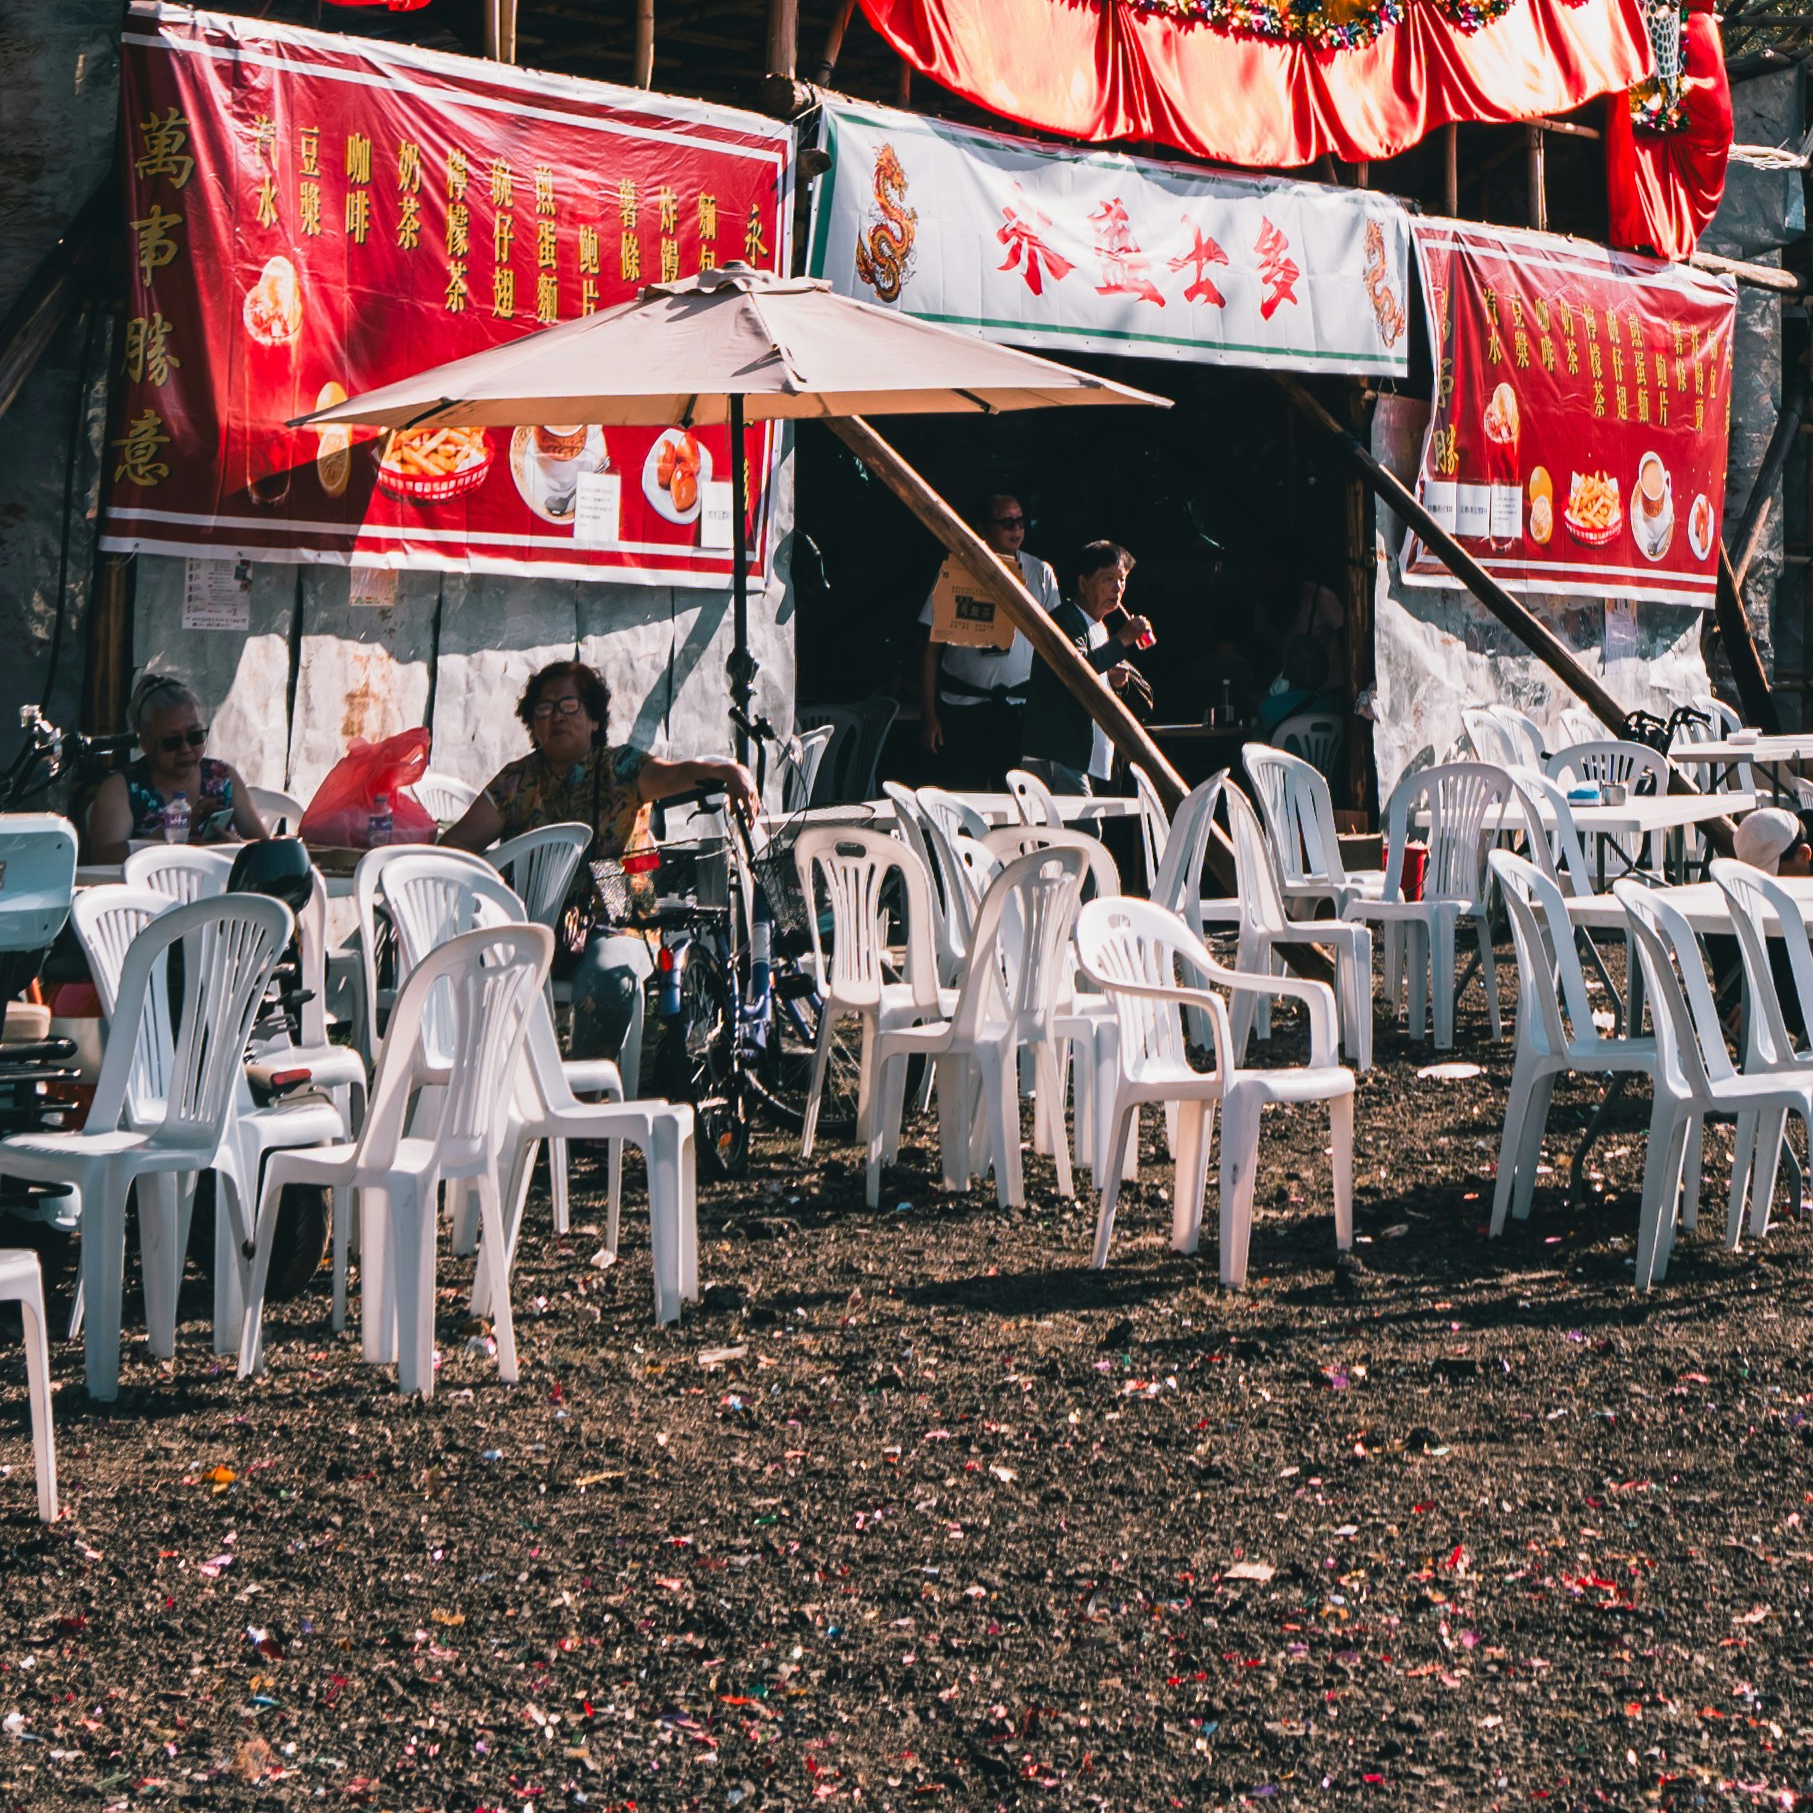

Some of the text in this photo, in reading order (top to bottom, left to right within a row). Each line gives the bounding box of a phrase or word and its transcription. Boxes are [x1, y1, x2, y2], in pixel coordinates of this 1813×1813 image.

[344, 132, 374, 245] 咖啡
[396, 138, 423, 251] 奶茶
[445, 148, 470, 314] 檸檬茶
[618, 177, 641, 283] 薯條
